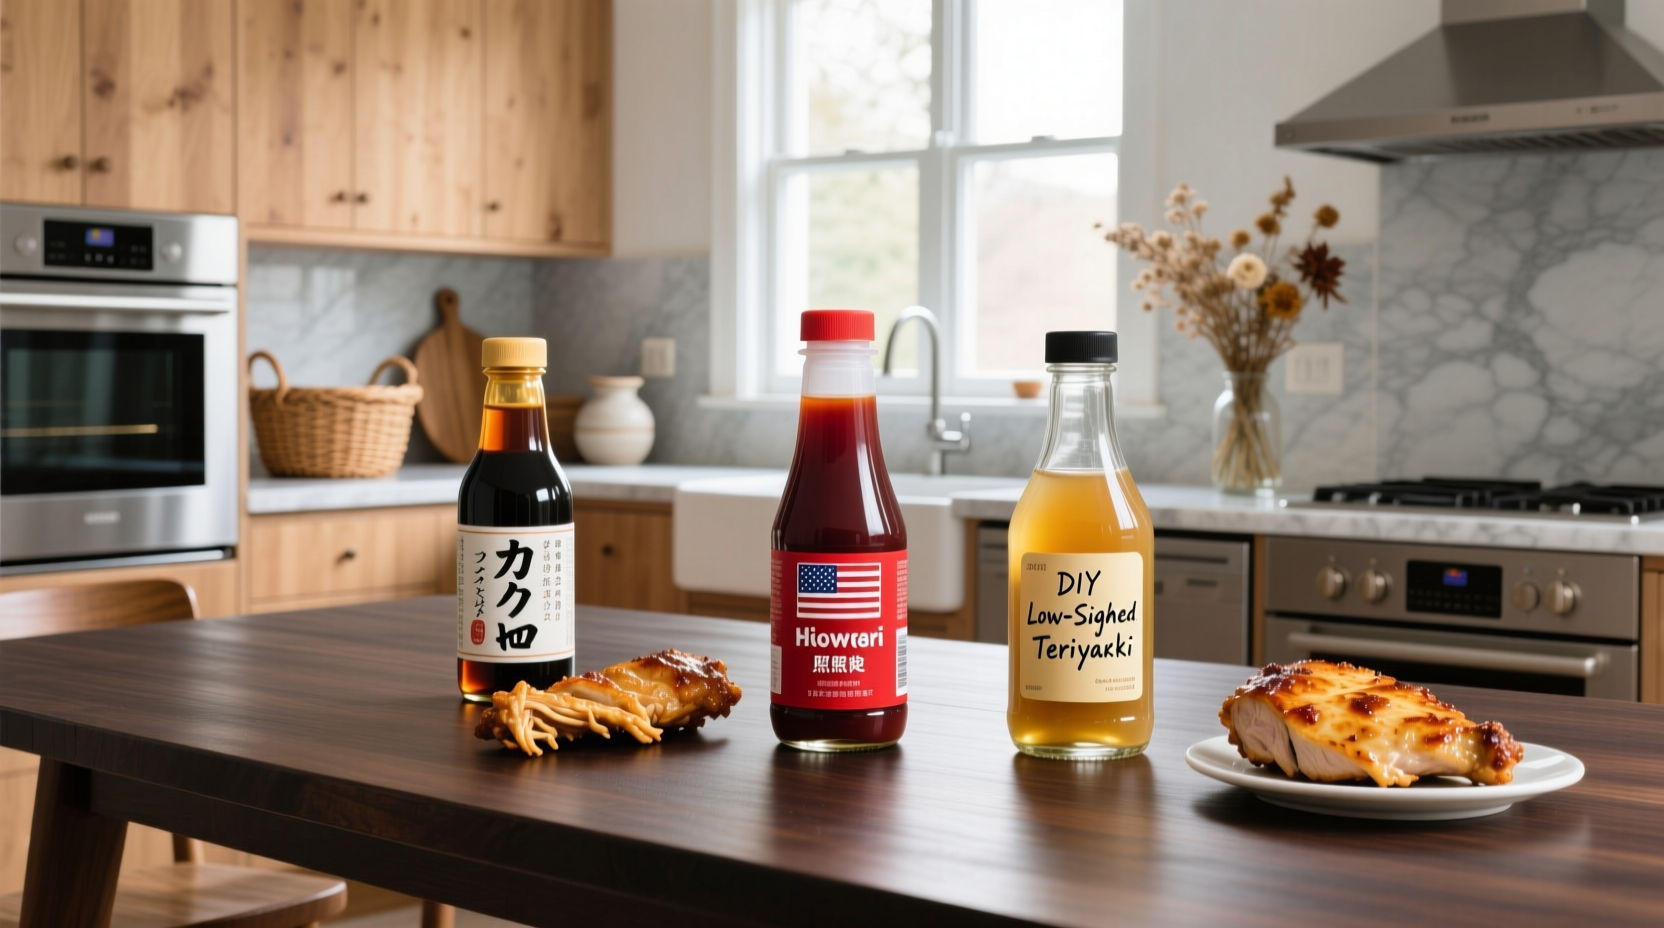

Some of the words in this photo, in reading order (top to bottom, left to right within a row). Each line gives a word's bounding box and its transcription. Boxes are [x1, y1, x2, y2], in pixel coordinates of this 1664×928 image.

[1057, 570, 1101, 596] DIY
[1027, 600, 1137, 637] Low-Sighed
[1032, 632, 1133, 671] Teriyakki
